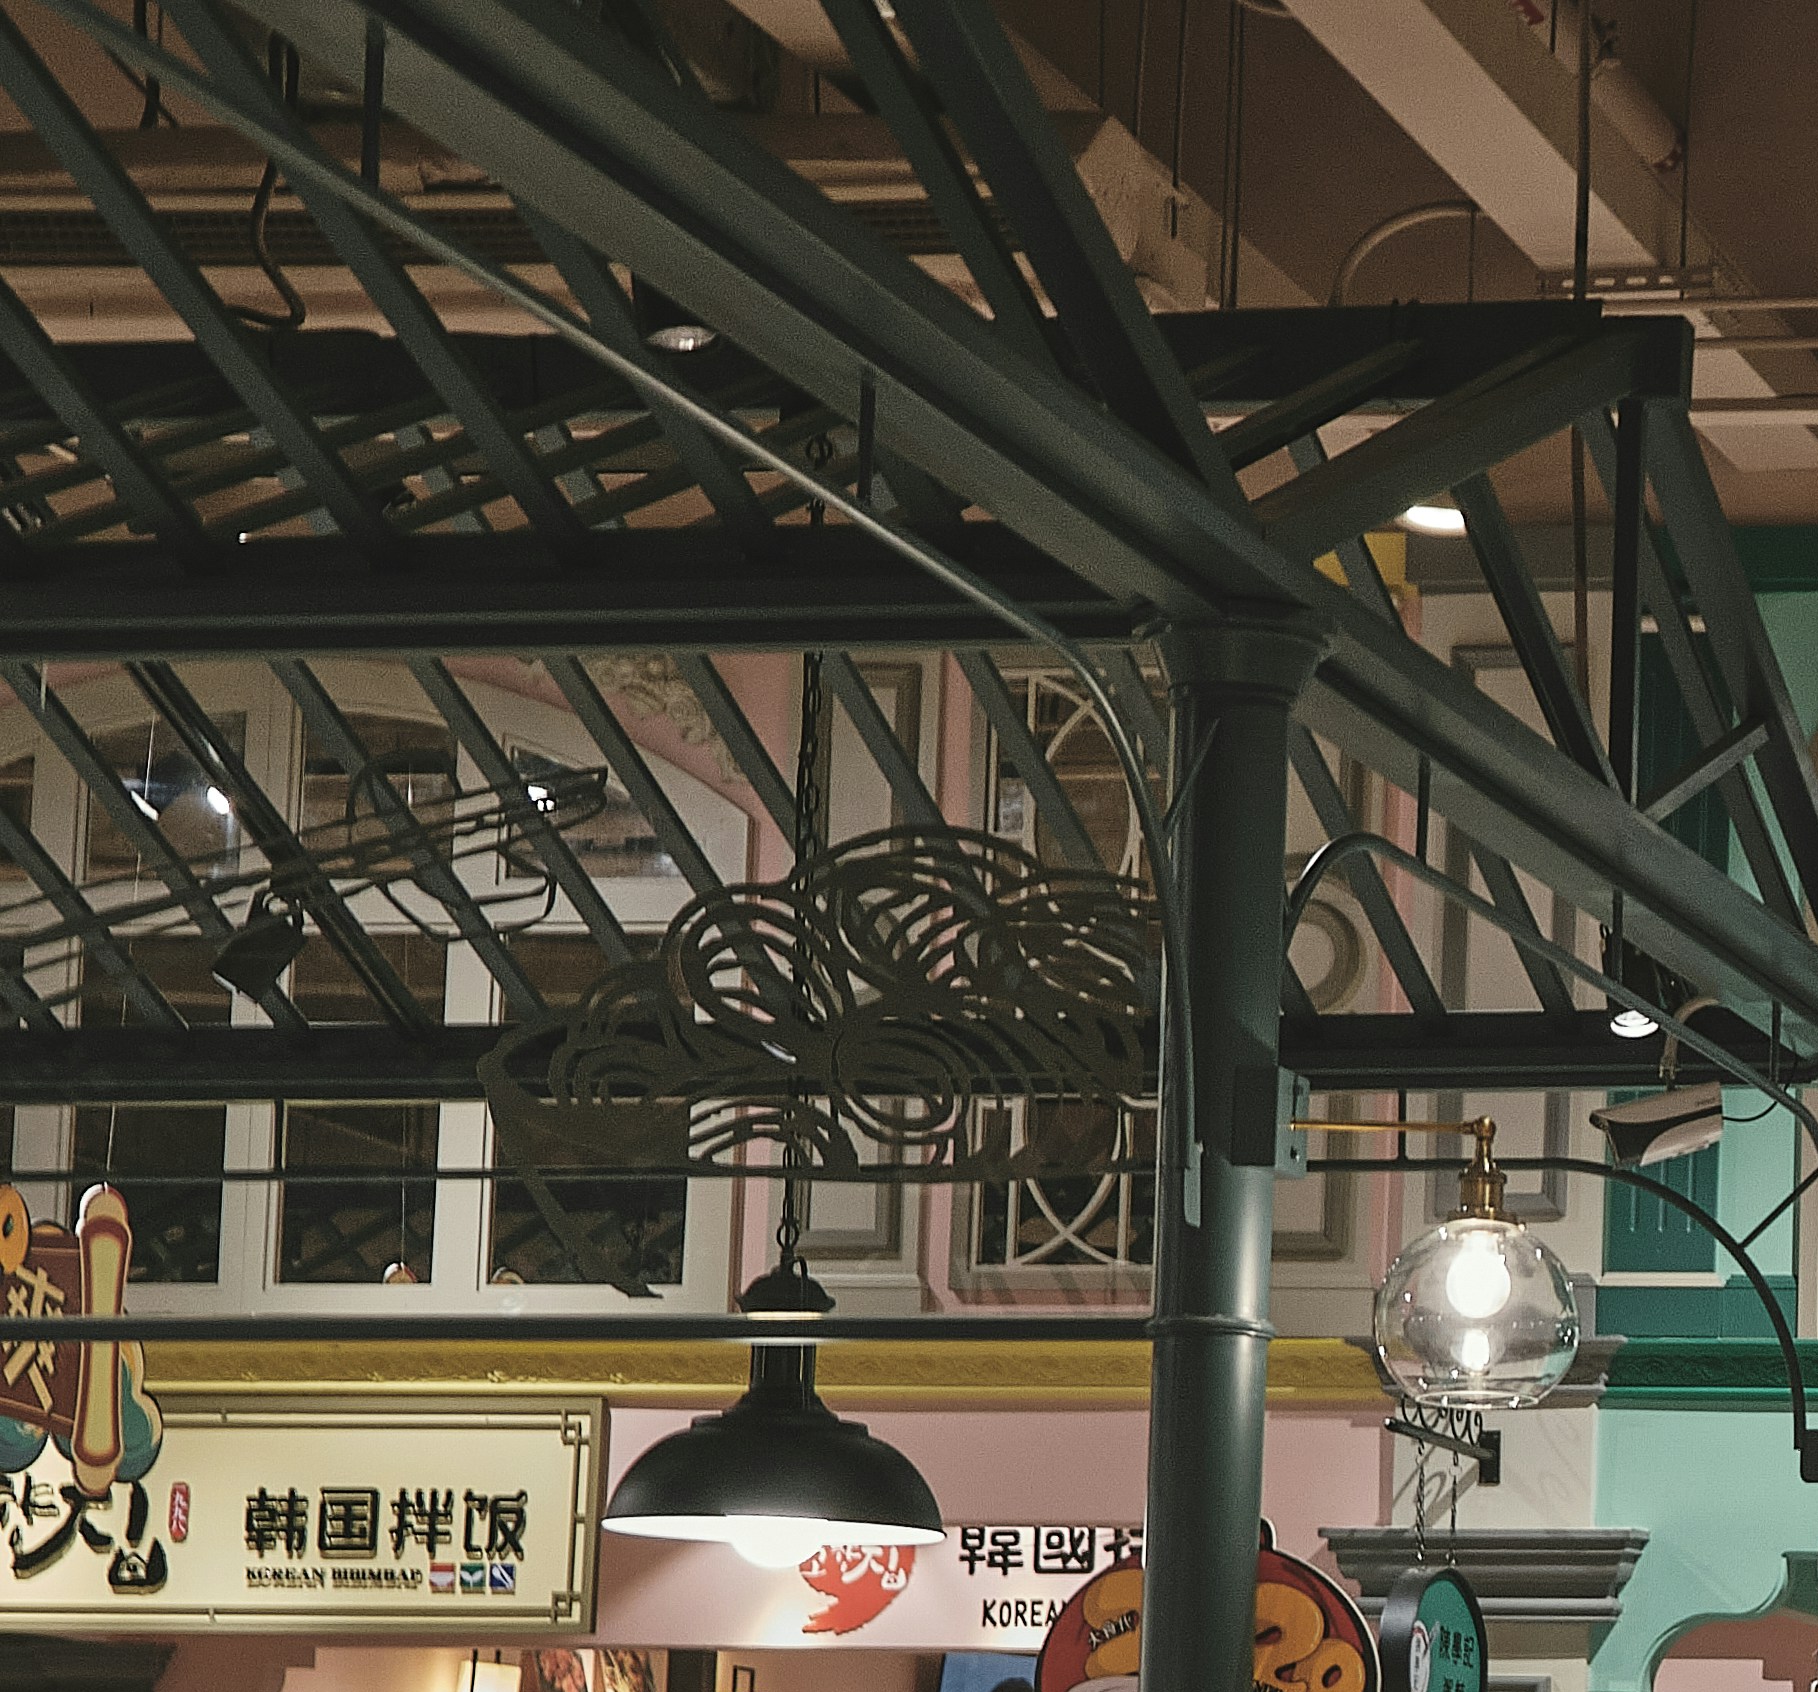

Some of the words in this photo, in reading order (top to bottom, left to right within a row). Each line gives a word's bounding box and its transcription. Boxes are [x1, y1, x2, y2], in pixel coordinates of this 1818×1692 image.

[244, 1486, 529, 1561] 韩国拌饭
[245, 1566, 325, 1590] KOREAN
[331, 1567, 423, 1590] BIBIMBAP
[982, 1599, 1071, 1627] KOREA
